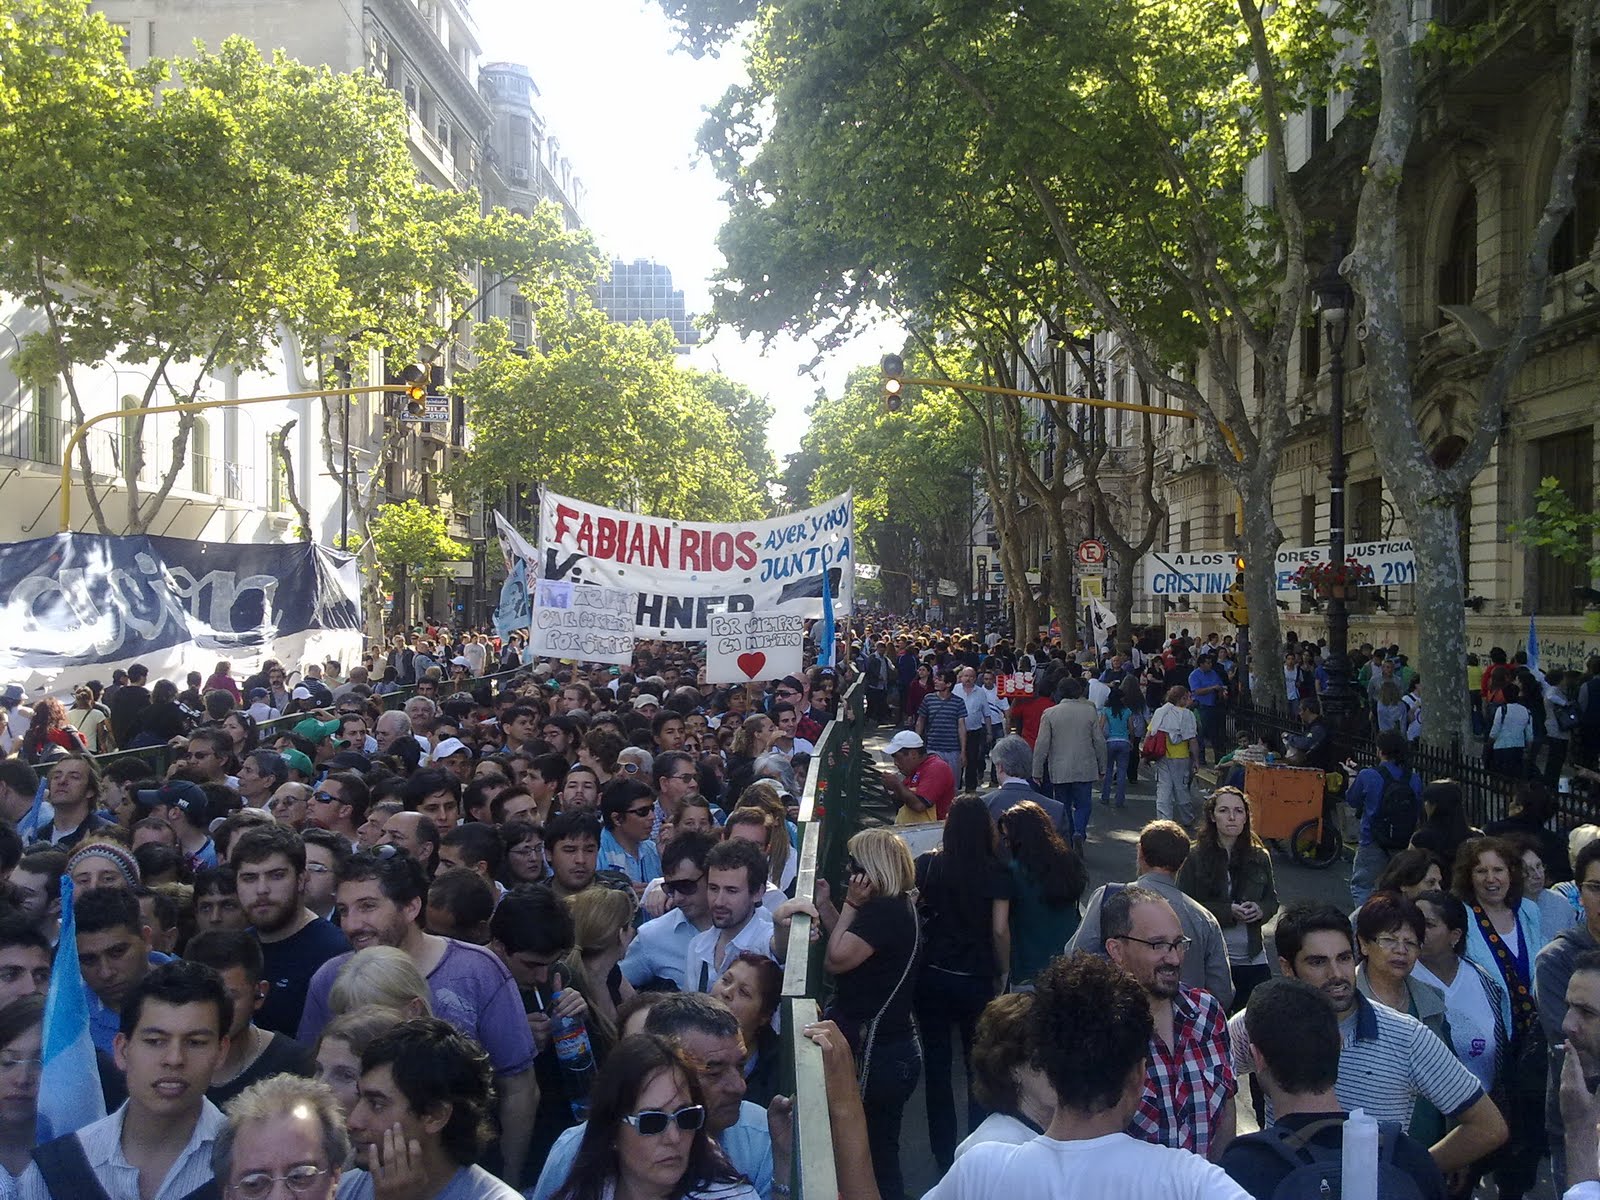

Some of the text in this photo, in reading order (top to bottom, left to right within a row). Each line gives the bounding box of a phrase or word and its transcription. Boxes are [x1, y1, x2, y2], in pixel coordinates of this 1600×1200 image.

[554, 503, 758, 572] FABIAN RIOS
[764, 499, 852, 551] AYER Y HOY
[760, 543, 833, 583] JUNTO
[836, 536, 850, 563] A
[1175, 555, 1184, 565] A
[1190, 555, 1223, 565] LOS
[1153, 572, 1232, 594] CRISTINA
[1381, 560, 1416, 585] 201
[711, 615, 803, 636] POR SIEMPRE
[546, 629, 581, 651] POR
[718, 632, 801, 655] EN NUESTRO
